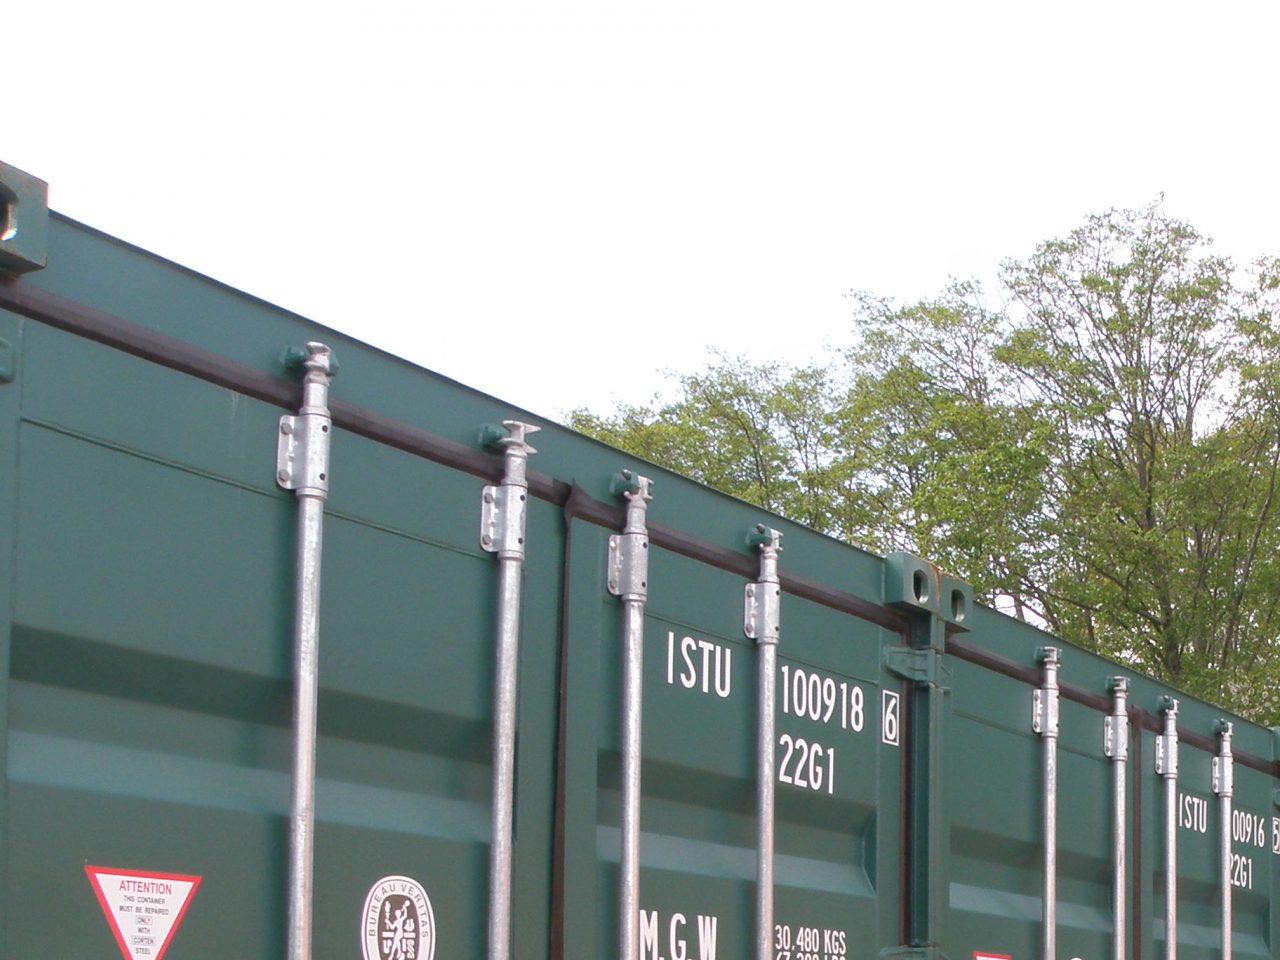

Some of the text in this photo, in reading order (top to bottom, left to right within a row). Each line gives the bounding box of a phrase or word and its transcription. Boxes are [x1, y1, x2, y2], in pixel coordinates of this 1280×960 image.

[667, 631, 731, 698] ISTU
[781, 665, 898, 743] 100918 6
[779, 734, 834, 794] 22G1
[1180, 793, 1207, 833] ISTU
[1232, 810, 1264, 847] 00916
[119, 880, 172, 895] ATTENTION
[369, 884, 429, 938] BUREAU VERITAS
[775, 925, 846, 955] 30,480 KGS
